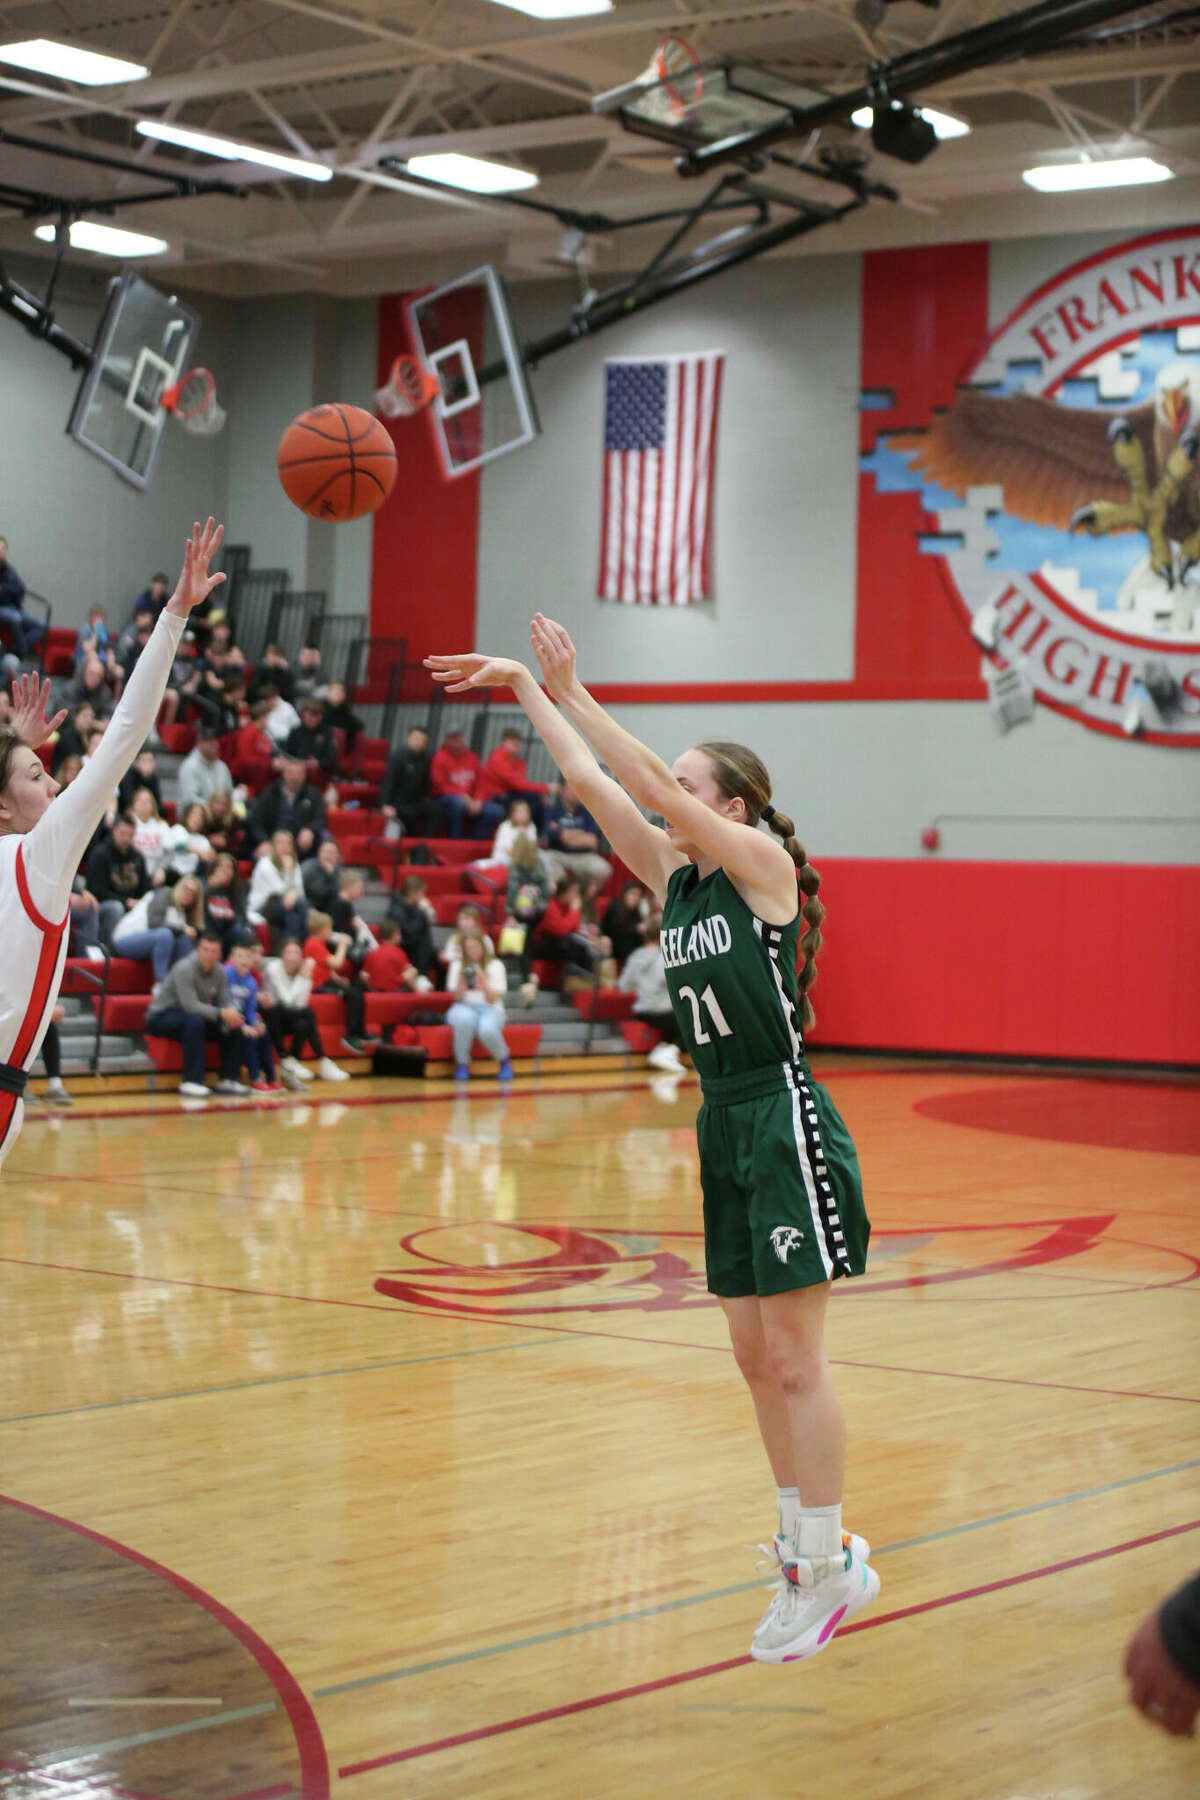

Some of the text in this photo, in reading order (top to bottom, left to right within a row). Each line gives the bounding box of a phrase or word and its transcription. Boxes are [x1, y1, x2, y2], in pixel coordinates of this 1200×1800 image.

[994, 583, 1132, 706] HIGH
[660, 914, 732, 969] EELAND
[678, 983, 734, 1045] 21
